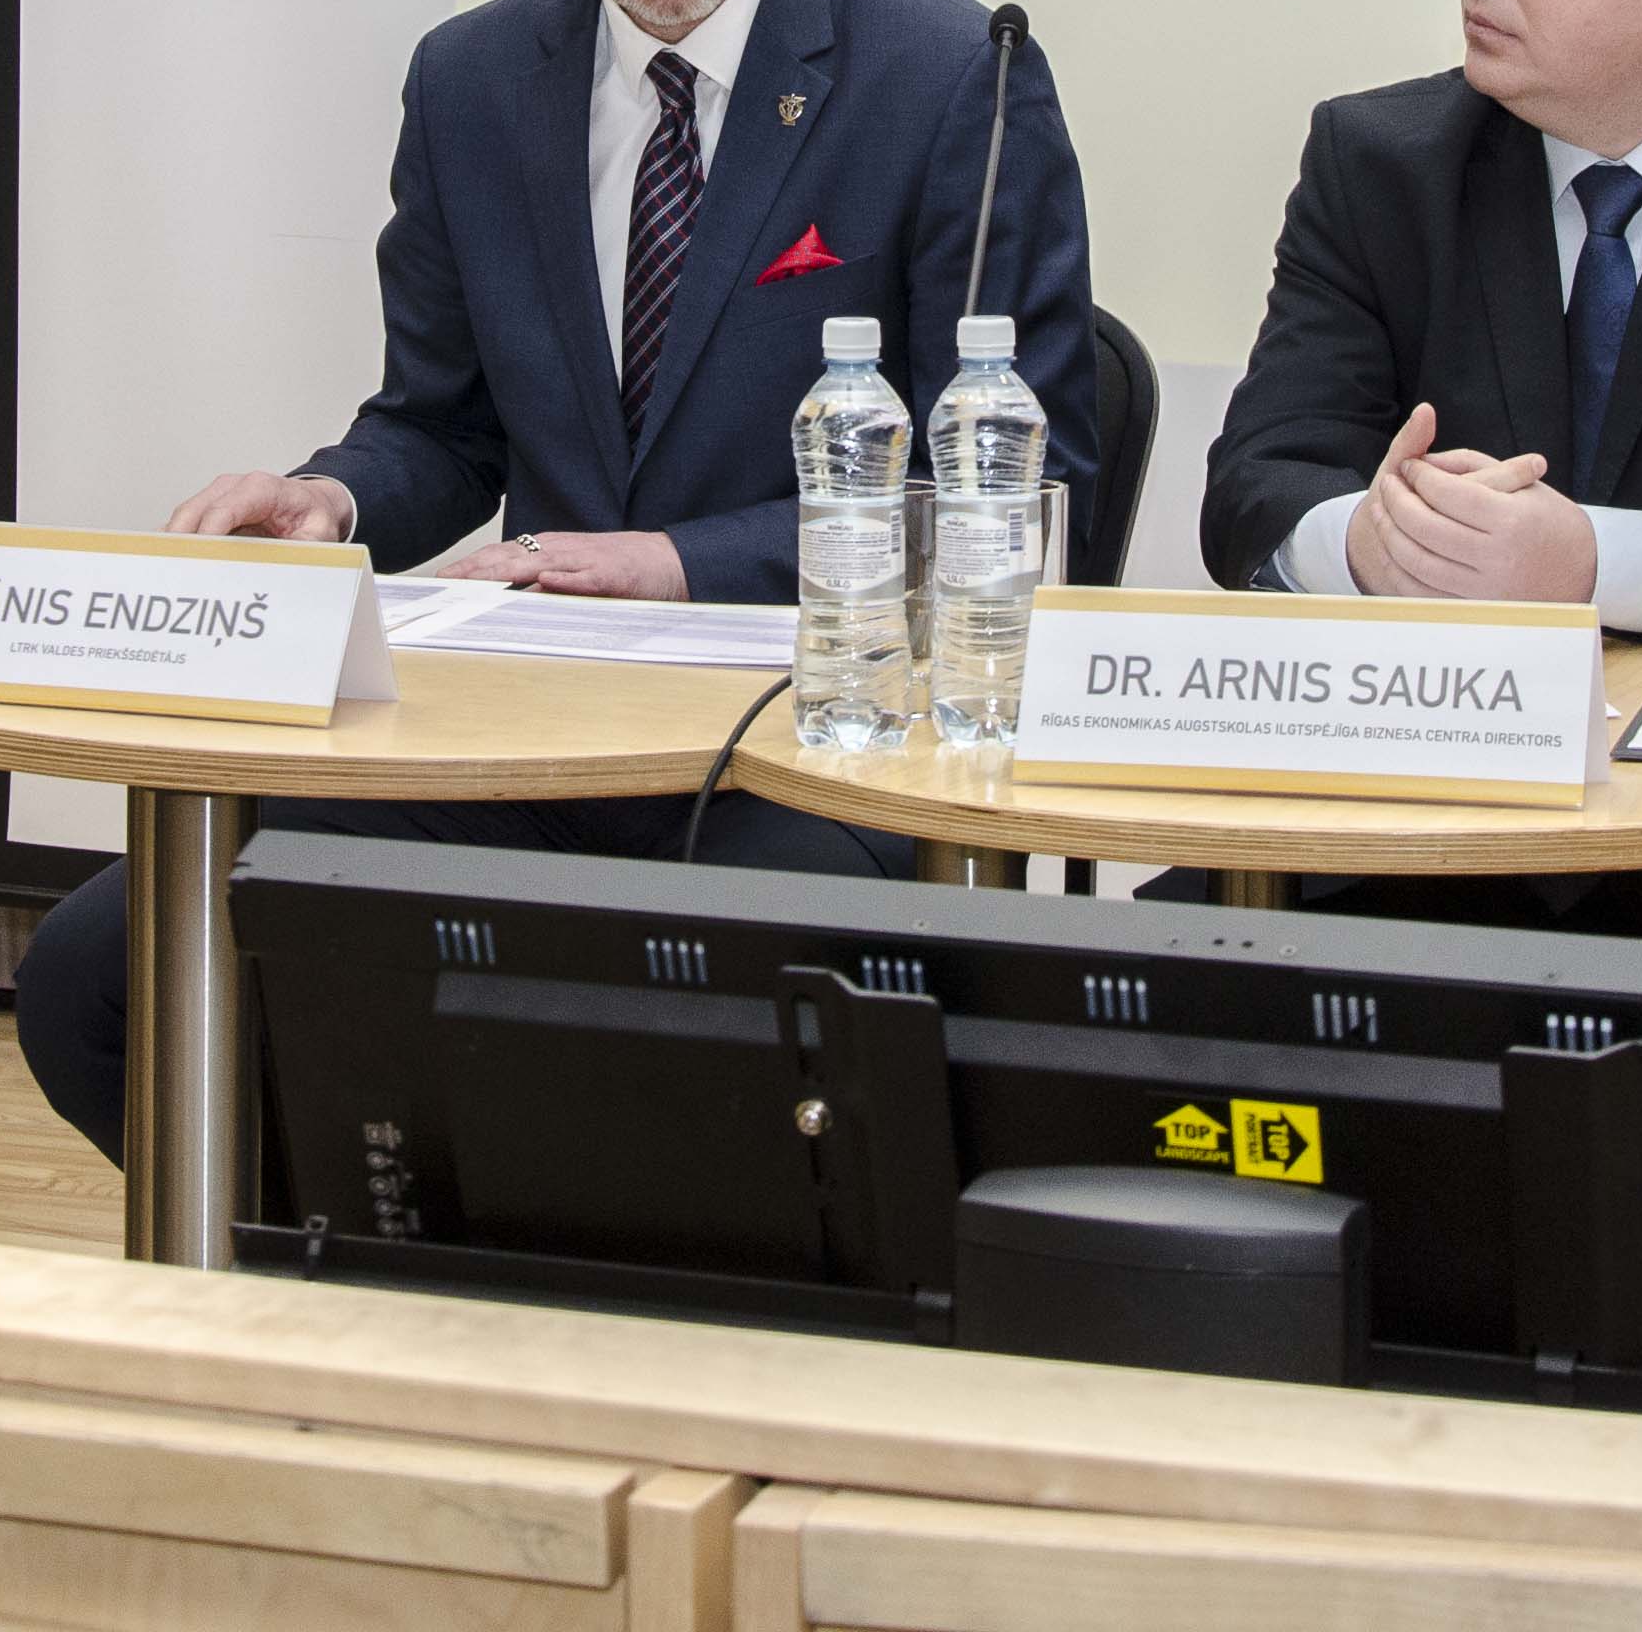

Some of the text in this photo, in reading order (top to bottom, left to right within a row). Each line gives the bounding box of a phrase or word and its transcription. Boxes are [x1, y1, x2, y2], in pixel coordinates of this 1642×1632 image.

[84, 590, 269, 648] ENDZIŅŠ
[10, 642, 187, 664] LTRK VALDES PRIEKŠSĒDĒTĀJS
[1086, 653, 1524, 712] DR. ARNIS SAUKA
[1041, 712, 1080, 728] RĪGAS
[1084, 715, 1171, 731] EKONOMIKAS
[1174, 719, 1272, 735] AUGSTSKOLAS
[1364, 726, 1422, 742] BIZNESA
[1425, 729, 1481, 744] CENTRA
[1484, 732, 1563, 748] DIREKTORS
[1173, 1123, 1210, 1140] TOP
[1267, 1124, 1290, 1161] TOP
